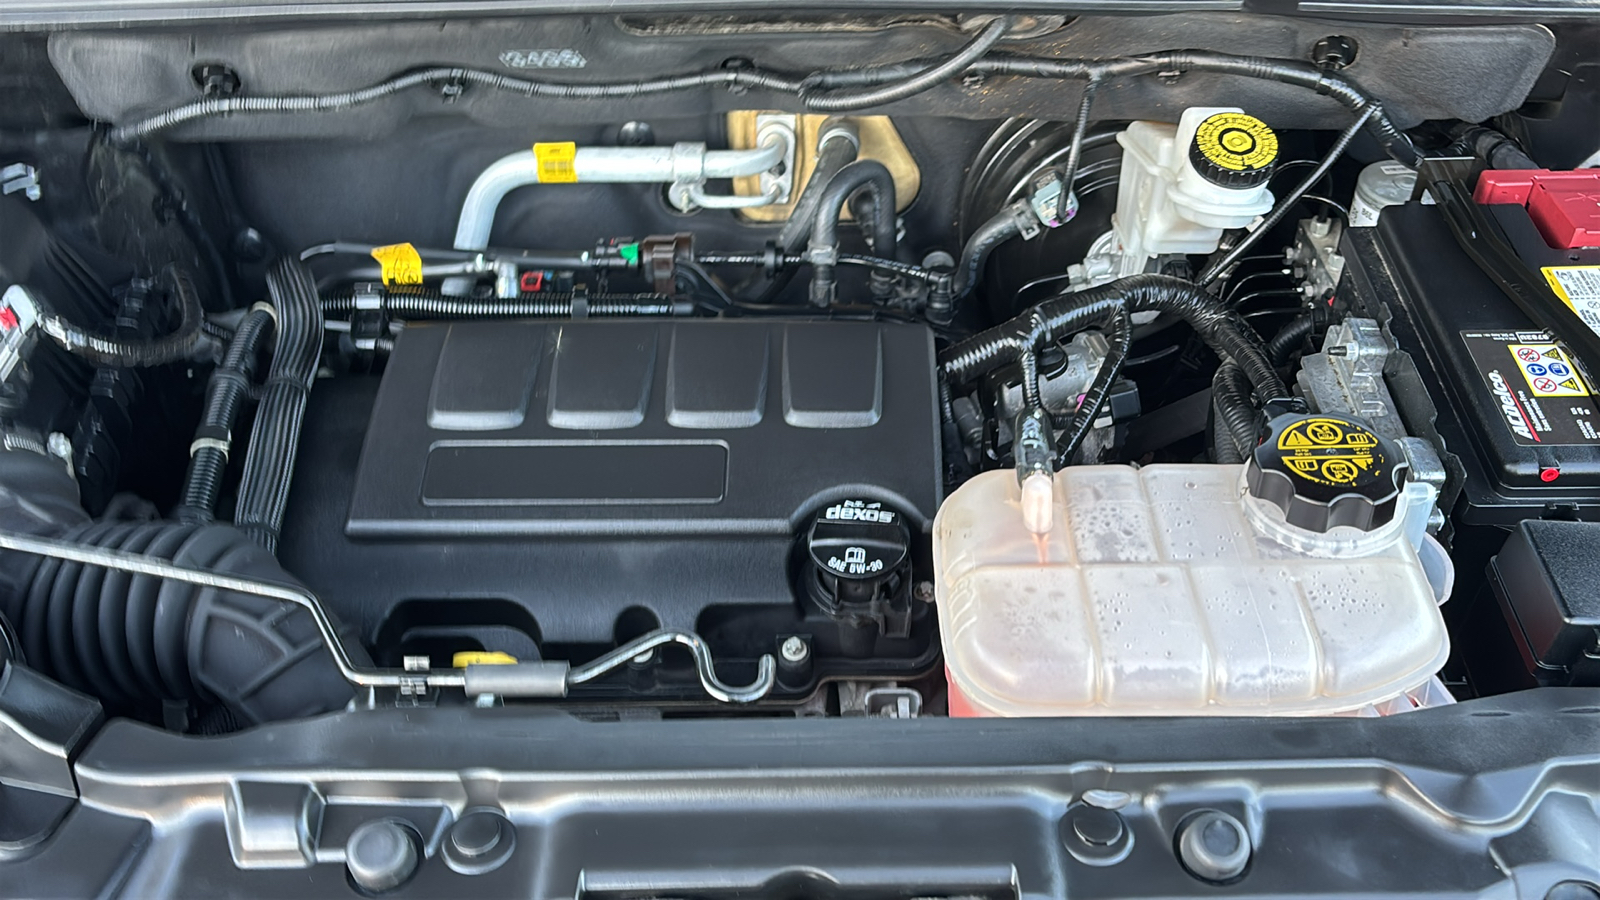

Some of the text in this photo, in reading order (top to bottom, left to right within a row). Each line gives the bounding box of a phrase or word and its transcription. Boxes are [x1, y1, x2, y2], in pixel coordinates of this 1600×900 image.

[1488, 372, 1533, 440] ACDelco
[826, 505, 892, 523] dexos
[828, 556, 847, 572] SAE
